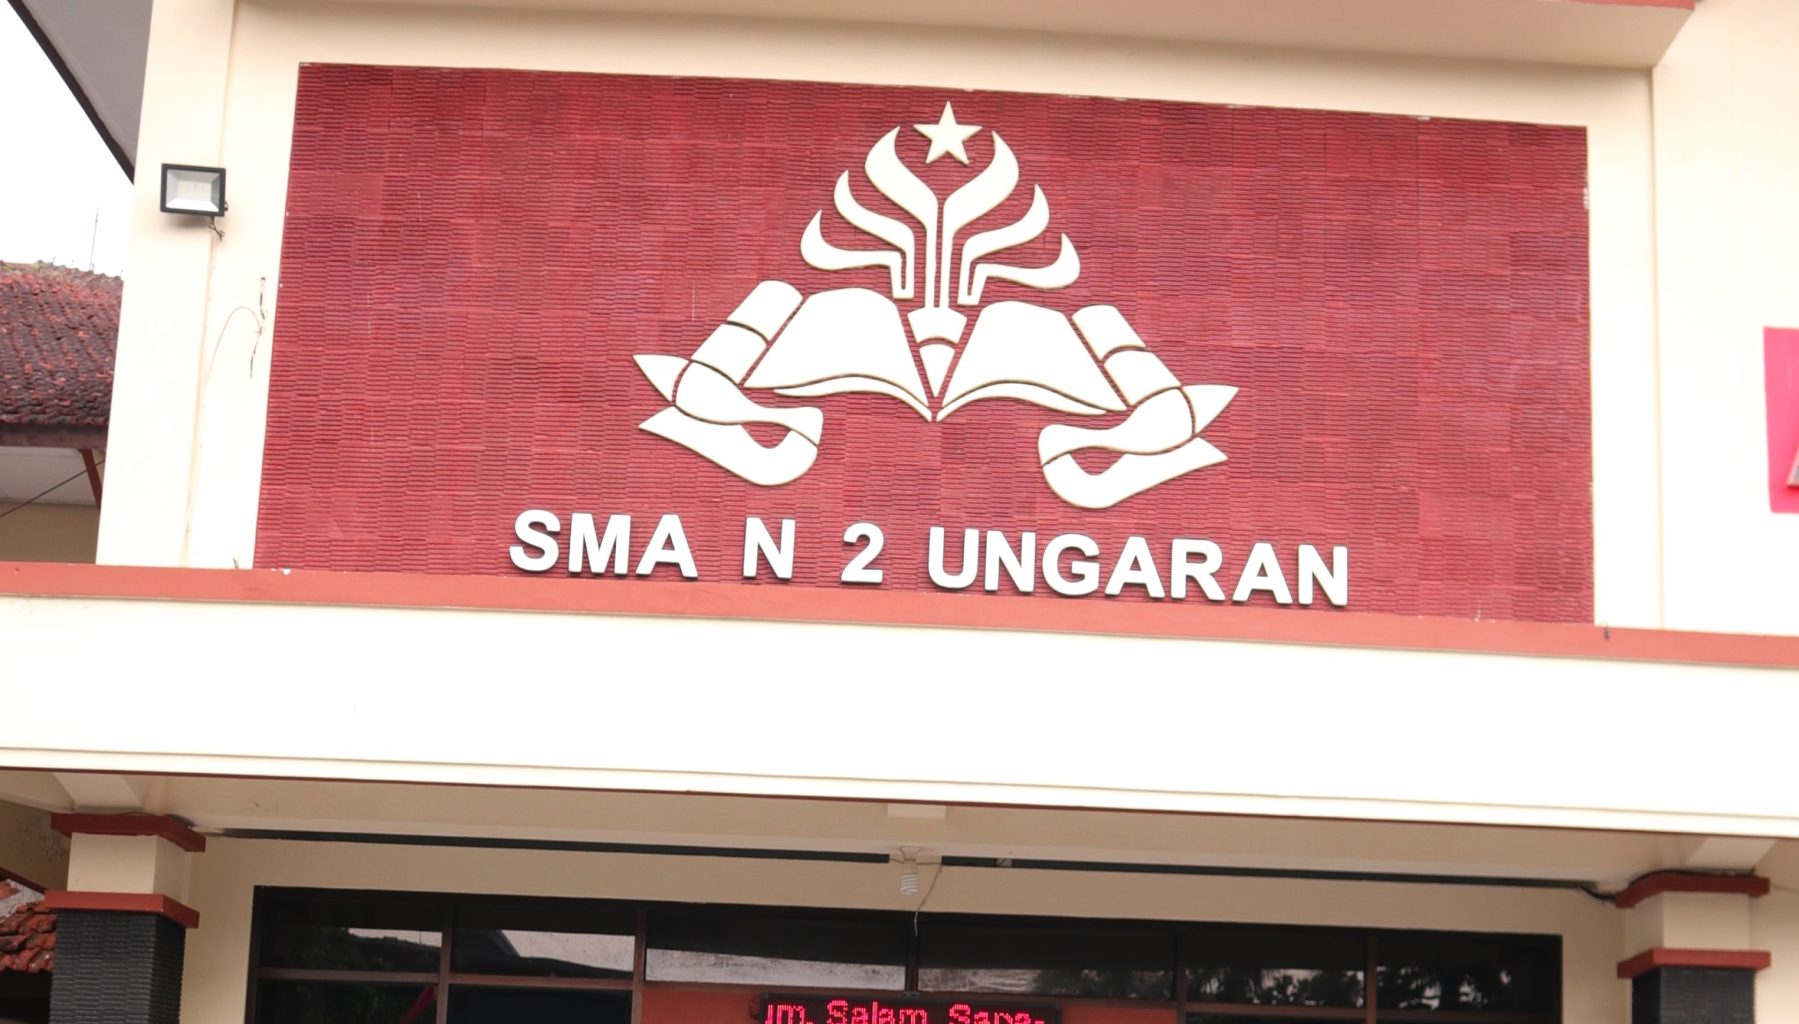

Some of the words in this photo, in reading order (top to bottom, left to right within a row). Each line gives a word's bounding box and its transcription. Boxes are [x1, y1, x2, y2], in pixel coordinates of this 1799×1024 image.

[508, 509, 699, 578] SMA
[742, 516, 796, 581] N
[840, 522, 884, 585] 2
[927, 525, 1349, 608] UNGARAN
